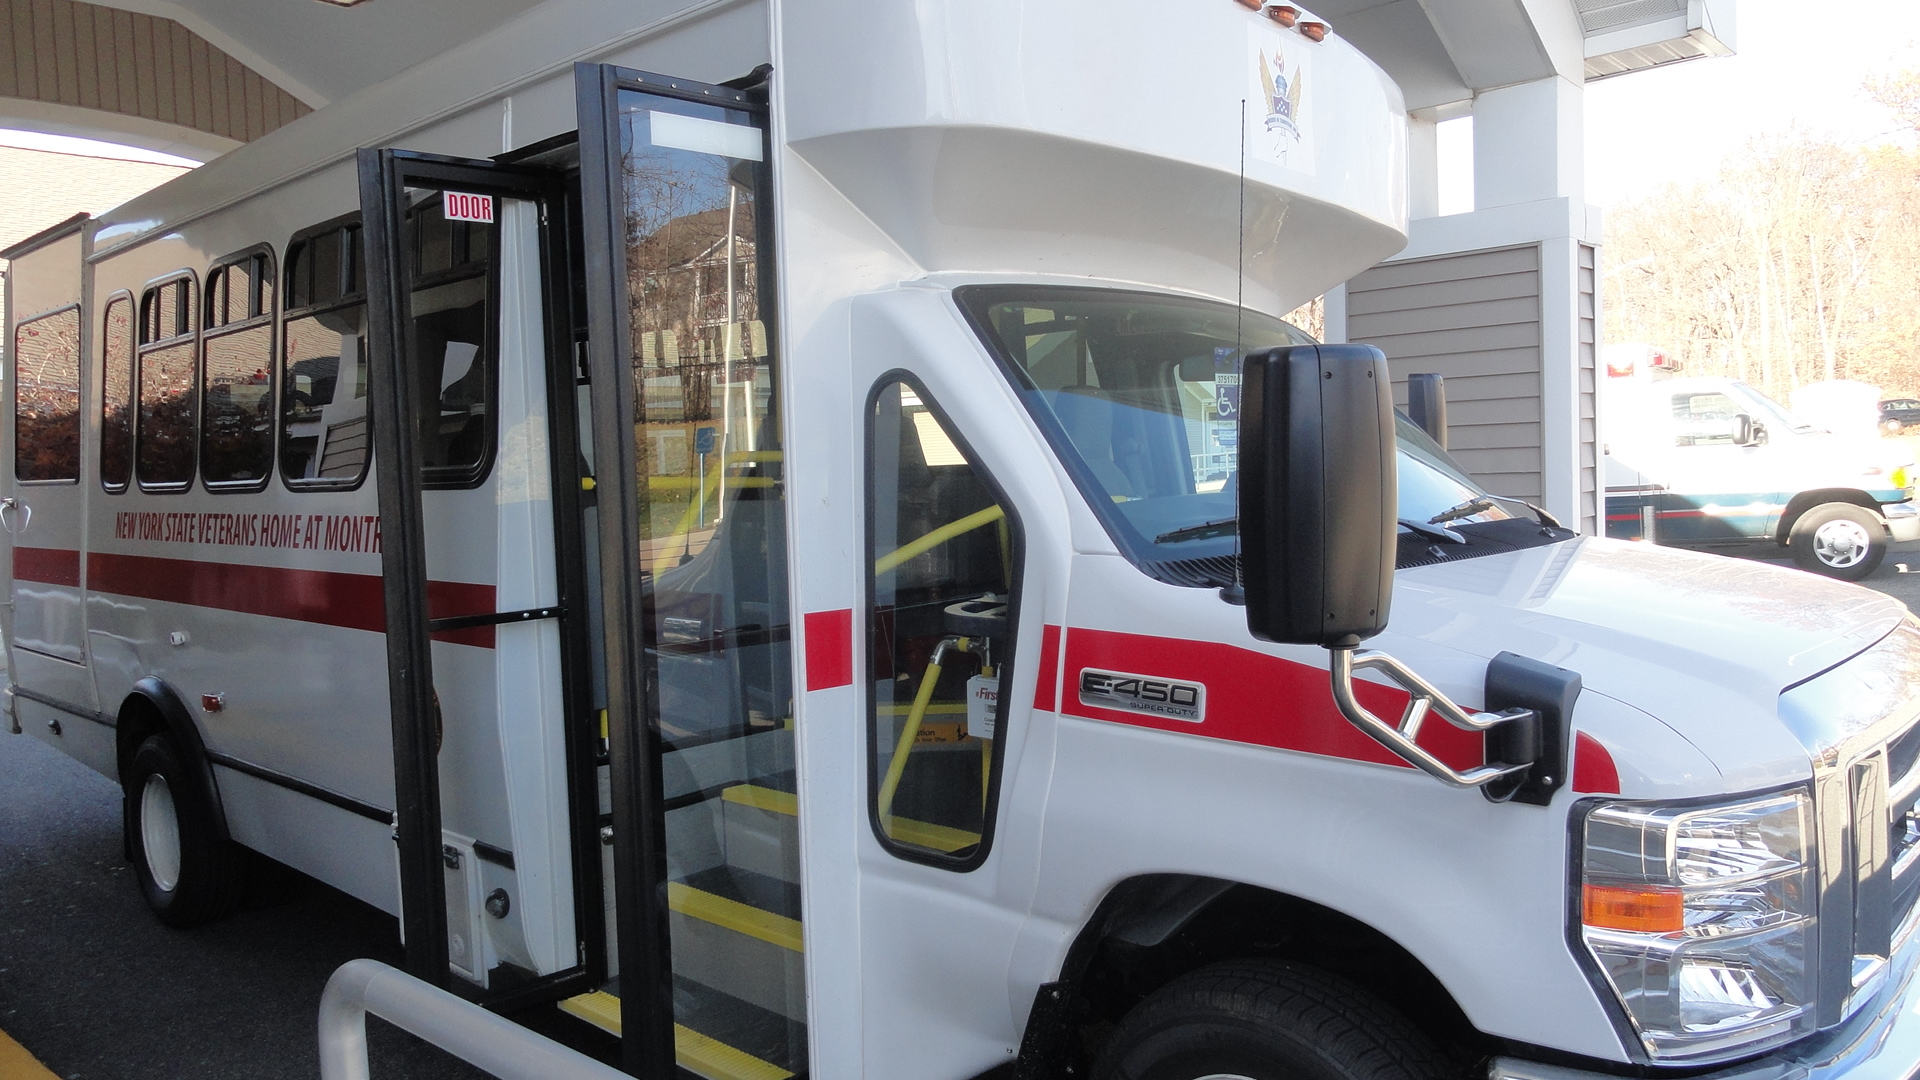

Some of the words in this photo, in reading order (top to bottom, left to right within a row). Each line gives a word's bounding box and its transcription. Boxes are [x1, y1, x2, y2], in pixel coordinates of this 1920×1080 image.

[448, 193, 492, 220] DOOR
[115, 512, 137, 539] NEW
[138, 512, 164, 541] YORK
[164, 513, 196, 543] STATE
[197, 513, 258, 546] VETERANS
[260, 514, 302, 548] HOME
[302, 514, 323, 550] AT
[1130, 701, 1164, 713] SUPER
[1166, 706, 1196, 717] DUTY
